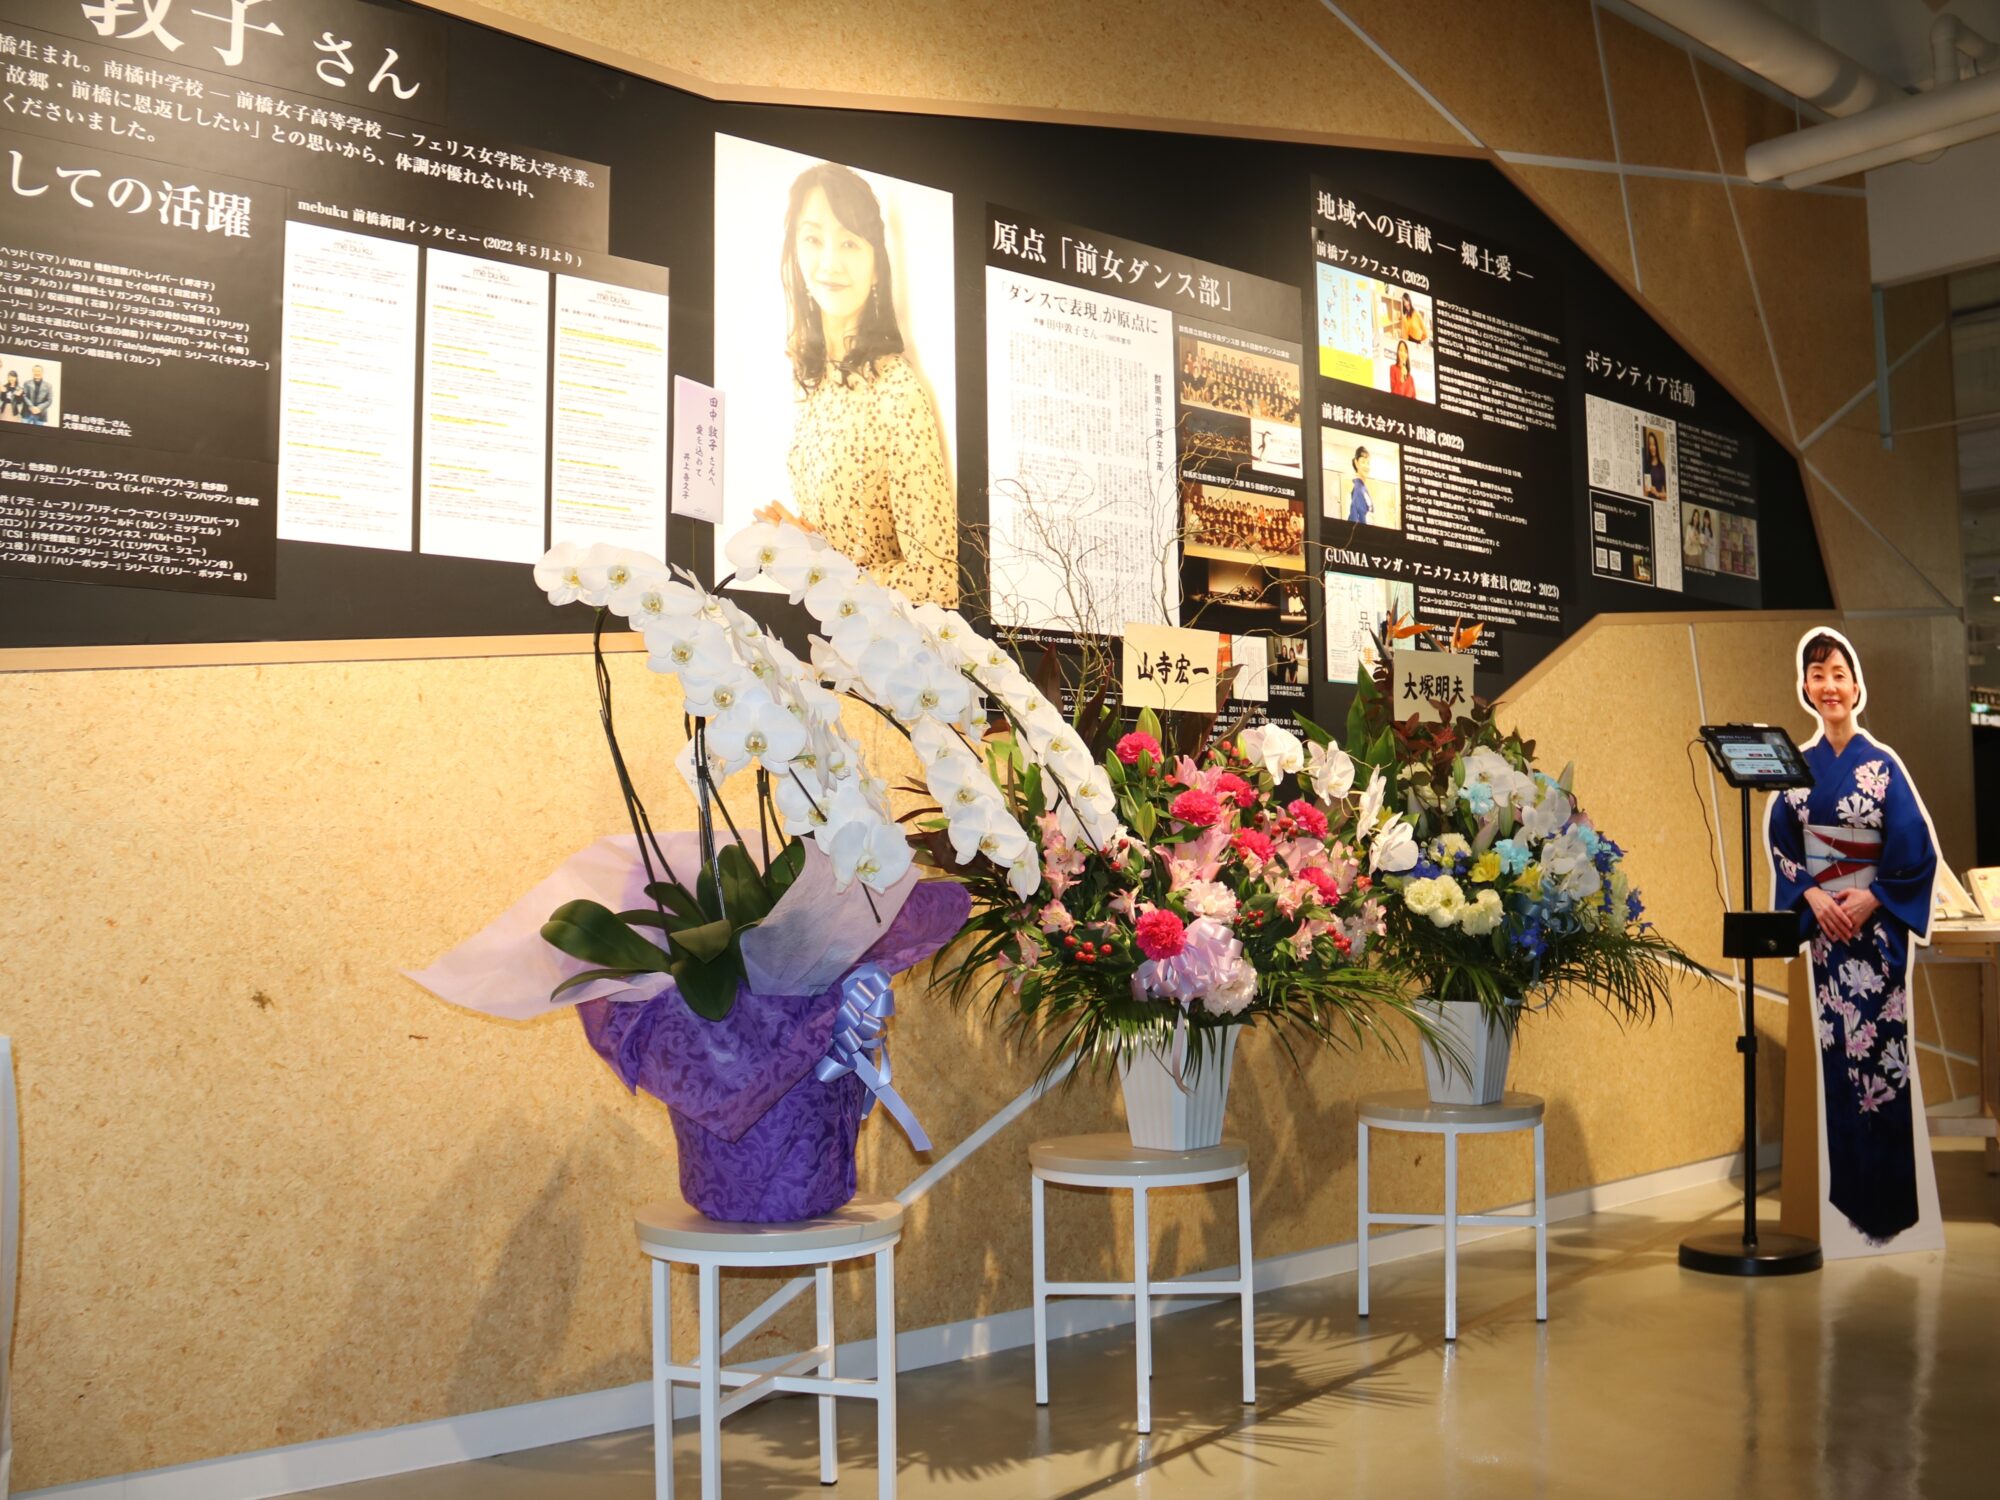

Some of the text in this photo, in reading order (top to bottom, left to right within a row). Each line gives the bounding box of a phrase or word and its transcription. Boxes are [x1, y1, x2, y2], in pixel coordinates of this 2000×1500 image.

[312, 32, 420, 100] さん
[2, 92, 157, 143] くださいました。
[236, 90, 382, 140] 前橋女子高等学校
[411, 132, 596, 189] フェリス女学院大学卒業。
[9, 149, 252, 239] しての活躍
[298, 199, 349, 220] mebuku
[1316, 190, 1433, 255] 地域への貢献
[1461, 241, 1512, 283] 郷土愛
[1316, 240, 1400, 278] 前橋ブックフェス
[992, 219, 1232, 312] 原点「前女ダンス部」
[1322, 402, 1465, 452] 前橋花火大会ゲスト出演 (2022)
[1325, 548, 1369, 568] GUNMA
[1372, 555, 1508, 592] マンガ・アニメフェスタ審査員
[1137, 650, 1210, 686] 山寺宏一
[1403, 671, 1466, 704] 大塚明夫
